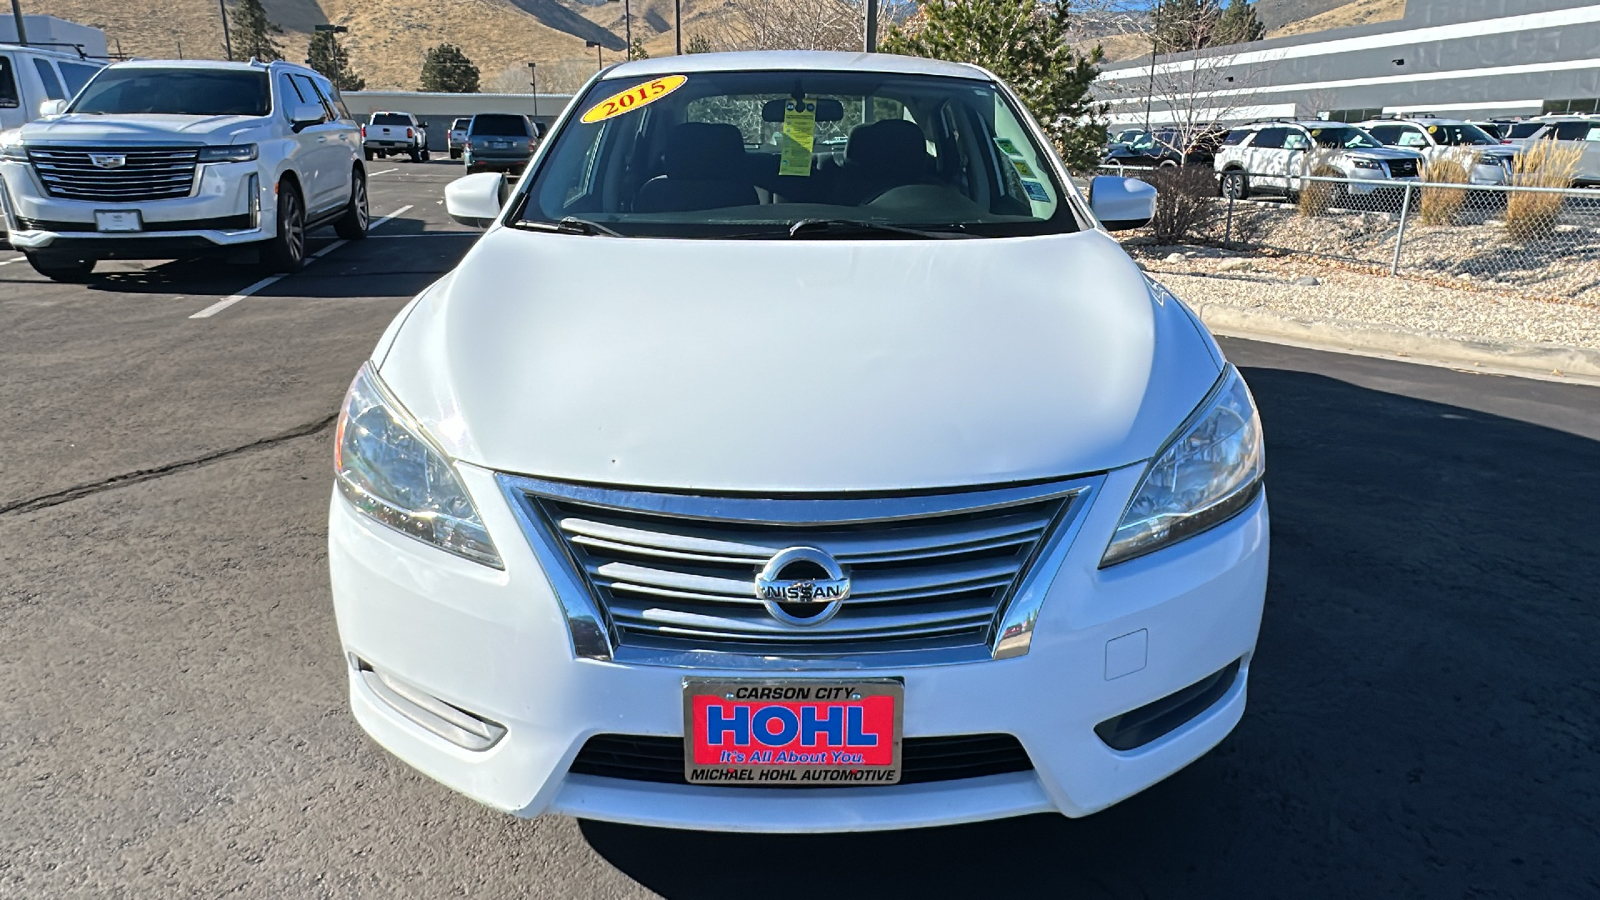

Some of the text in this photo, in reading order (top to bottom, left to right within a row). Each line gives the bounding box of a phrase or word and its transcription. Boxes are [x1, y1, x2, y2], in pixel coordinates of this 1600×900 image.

[602, 80, 666, 117] 2015
[766, 585, 840, 600] NISSAN
[735, 687, 856, 700] CARSON CITY
[706, 704, 879, 748] HOHL
[719, 749, 866, 764] It's All About You.
[690, 768, 896, 781] MICHAEL HOHL AUTOMOTIVE
